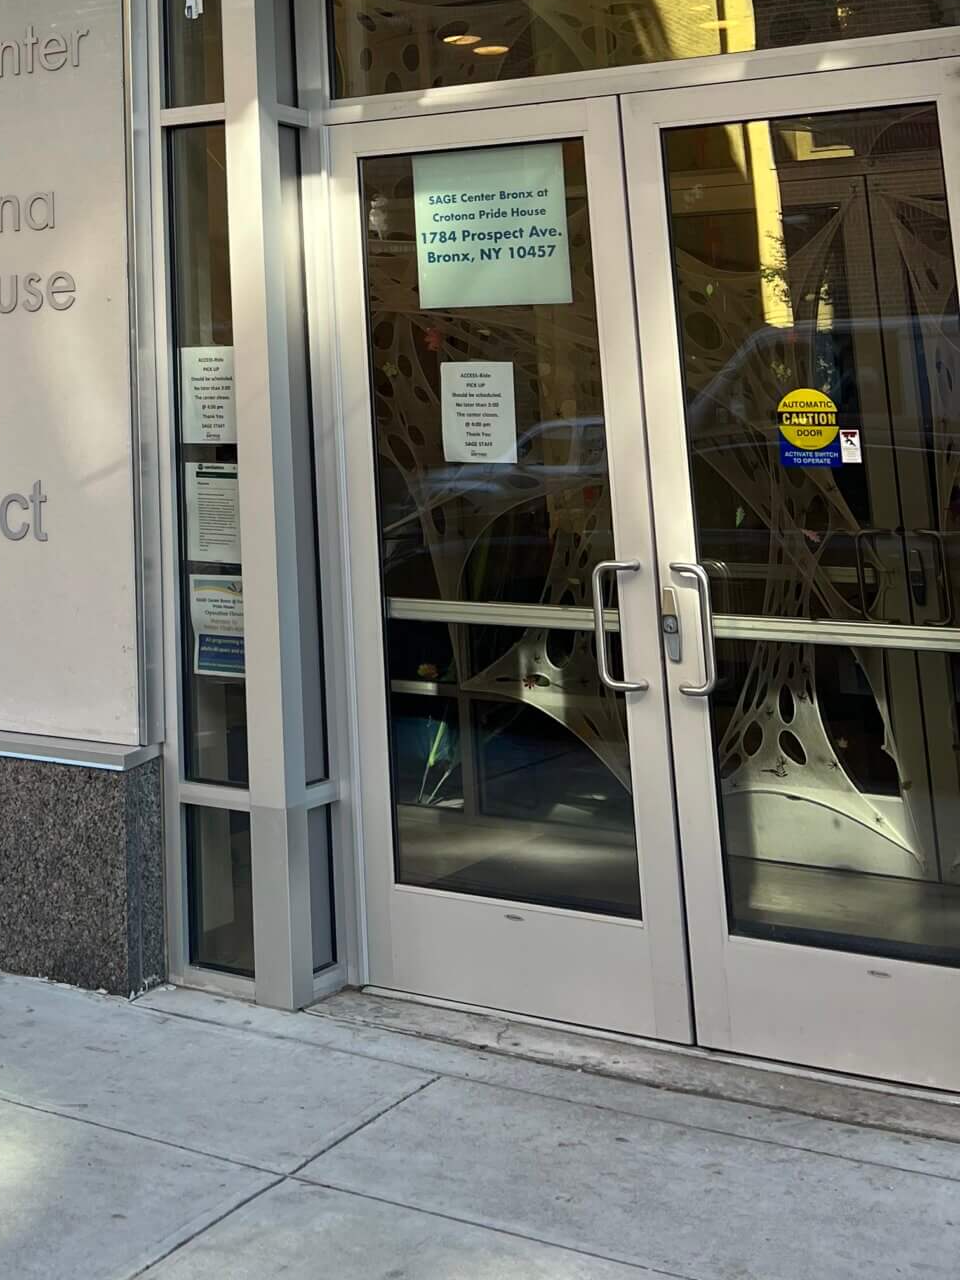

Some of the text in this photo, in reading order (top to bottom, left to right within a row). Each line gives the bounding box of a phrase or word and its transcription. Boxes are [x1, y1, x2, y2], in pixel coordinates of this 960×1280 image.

[428, 188, 548, 205] SAGE Center Bronx at
[432, 206, 547, 223] Crotona Pride House
[421, 225, 563, 244] 1784 Prospect Ave.
[427, 244, 557, 264] Bronx, NY 10457
[782, 413, 836, 425] CAUTION
[796, 429, 822, 437] DOOR
